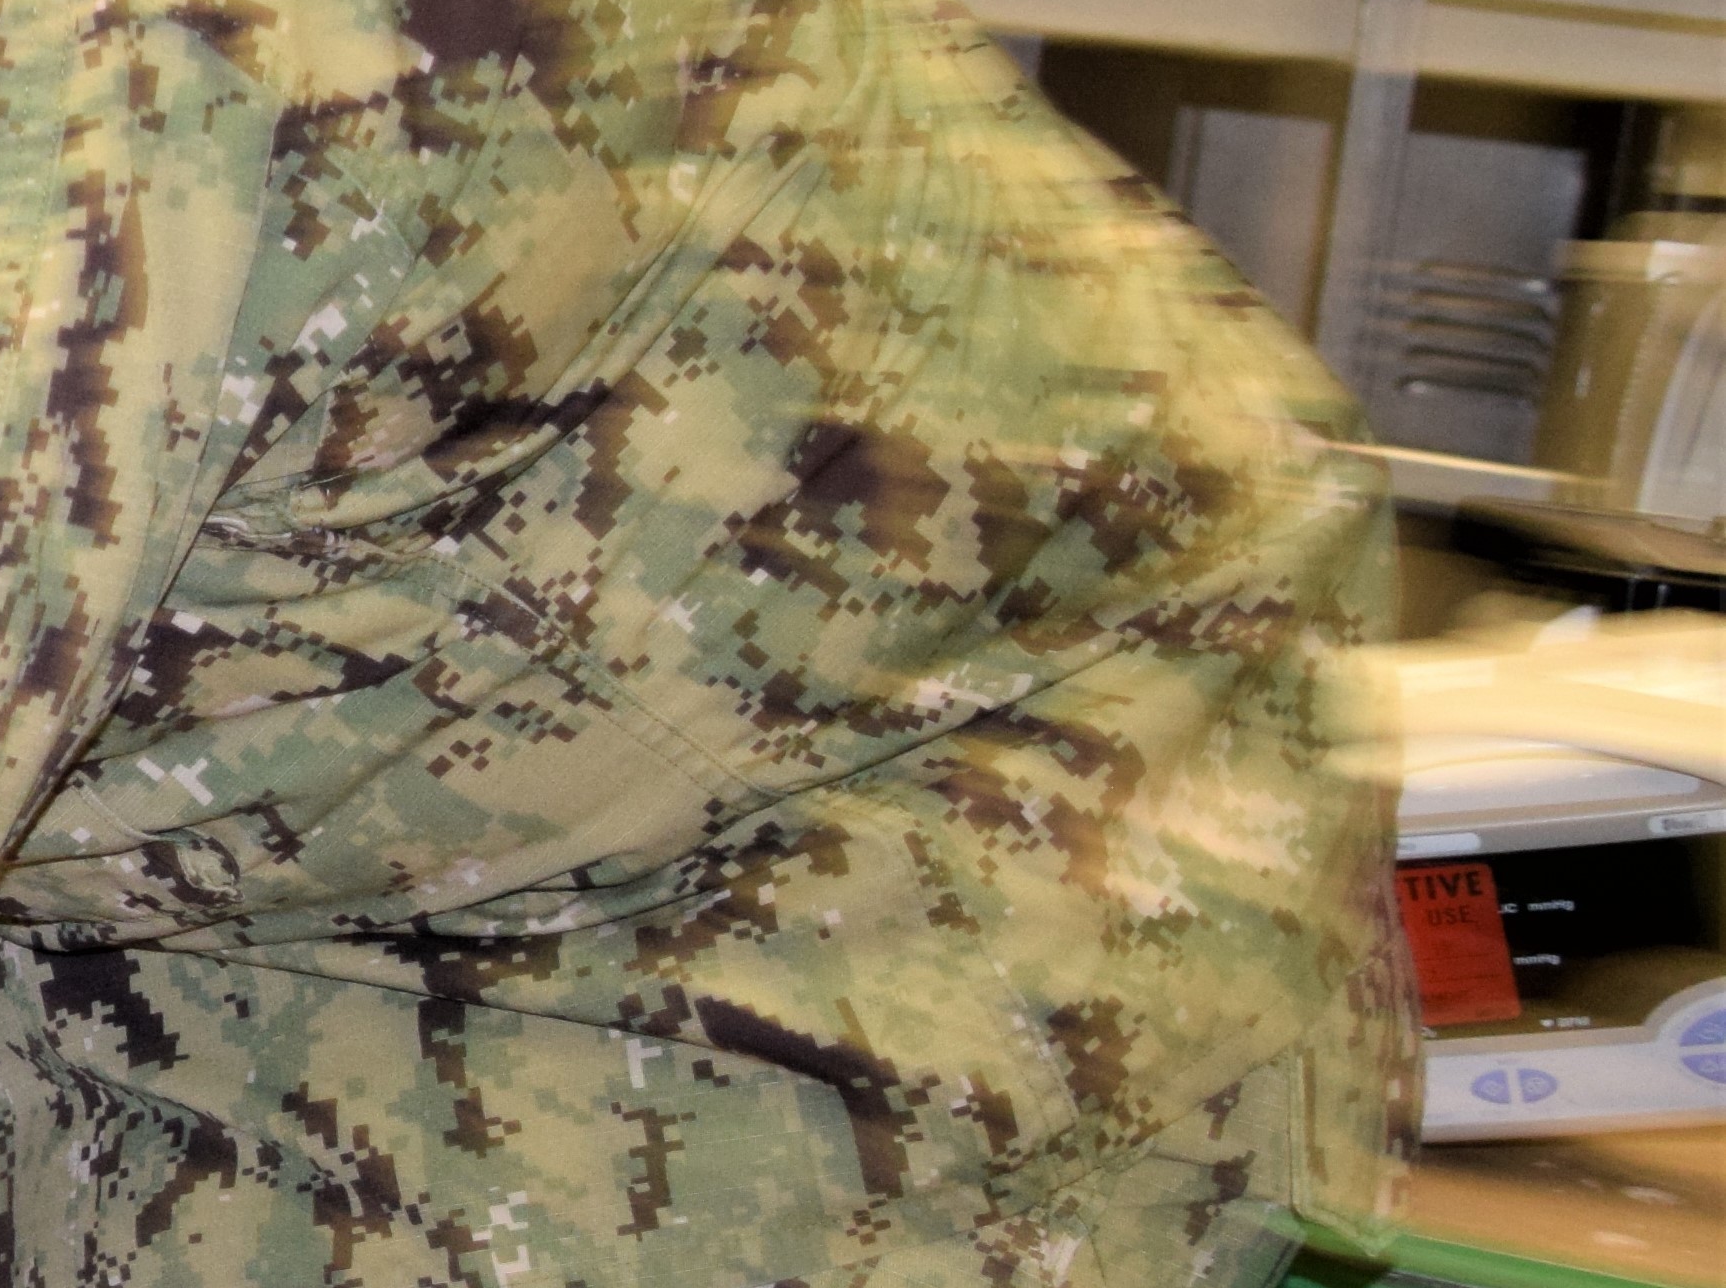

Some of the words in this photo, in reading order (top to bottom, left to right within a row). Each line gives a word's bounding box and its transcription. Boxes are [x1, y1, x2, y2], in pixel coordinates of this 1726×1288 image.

[1397, 870, 1484, 902] TIVE
[1527, 898, 1576, 913] mmHg
[1427, 905, 1474, 926] USE
[1513, 952, 1563, 967] mmHg
